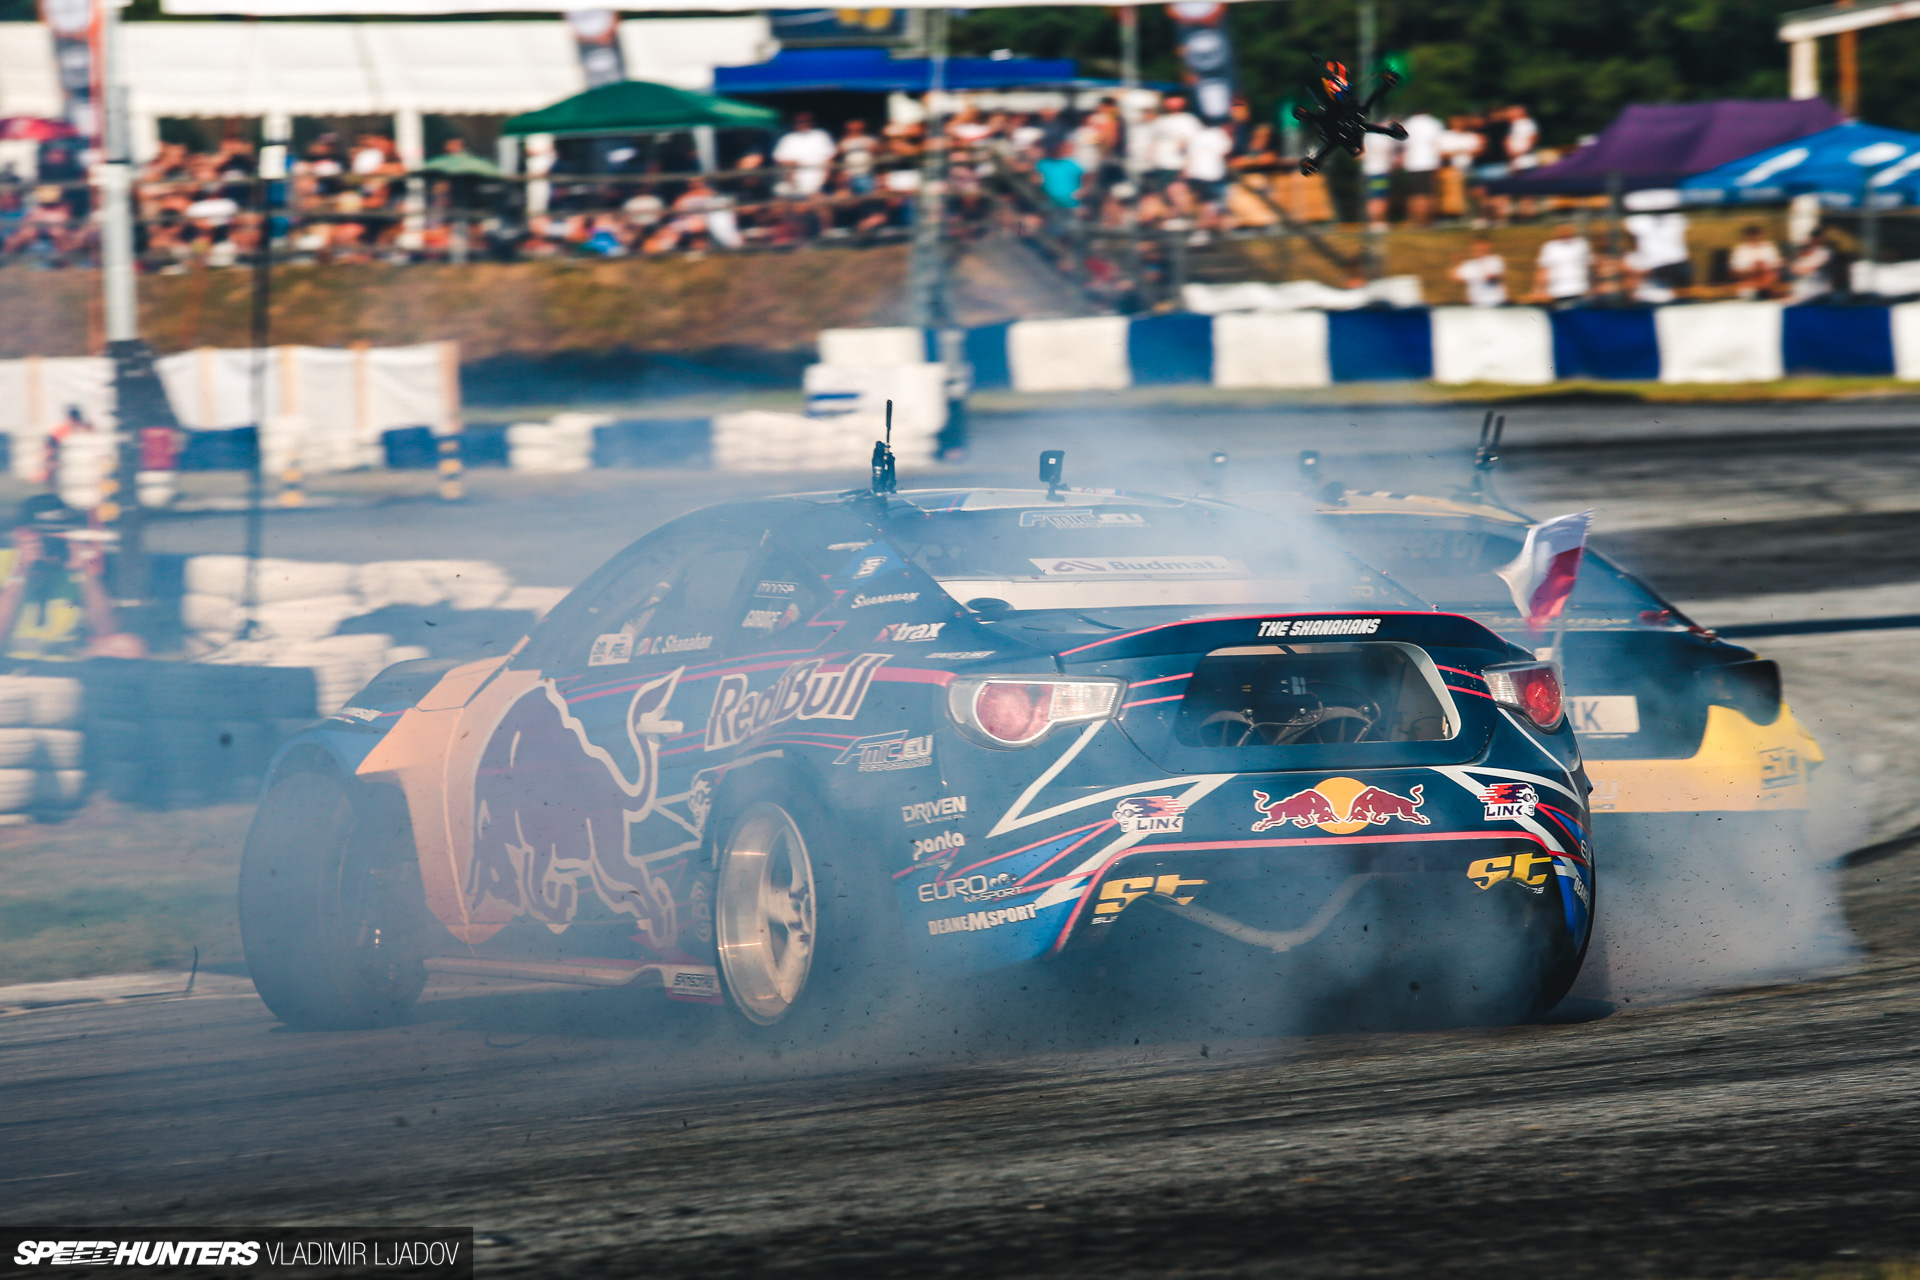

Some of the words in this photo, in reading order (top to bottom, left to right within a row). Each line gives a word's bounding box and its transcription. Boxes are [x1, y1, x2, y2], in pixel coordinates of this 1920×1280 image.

[1258, 621, 1292, 637] THE
[1289, 618, 1382, 636] SHANAHANS
[901, 796, 967, 823] DRIVEN
[1486, 804, 1523, 817] LINK
[1137, 817, 1182, 831] LINK
[912, 830, 966, 861] panta
[918, 874, 989, 902] EURO
